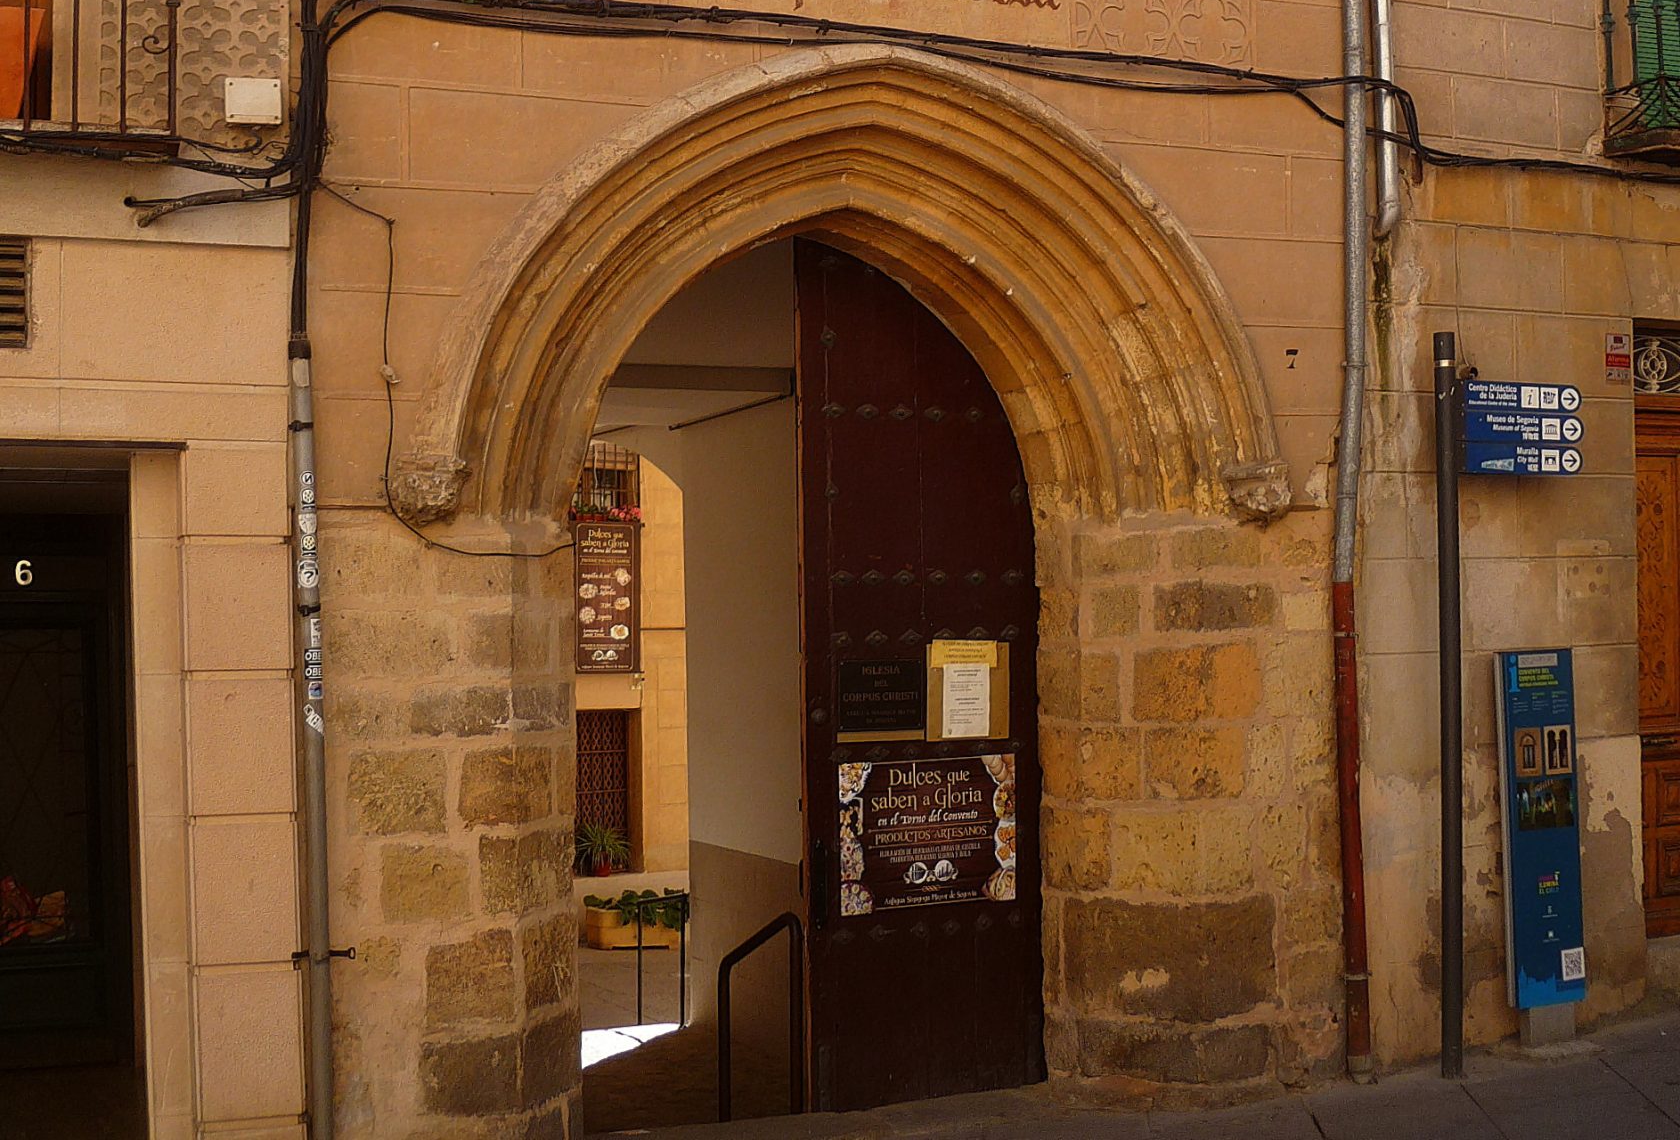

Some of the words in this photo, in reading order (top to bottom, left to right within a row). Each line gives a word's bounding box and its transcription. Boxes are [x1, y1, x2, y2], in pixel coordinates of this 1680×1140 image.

[1285, 348, 1299, 369] 7
[1468, 383, 1489, 392] Centro
[1489, 384, 1517, 393] Didáctico
[1488, 392, 1495, 400] la
[1486, 414, 1506, 424] Museo
[1507, 415, 1515, 424] de
[1516, 415, 1539, 425] Segovia
[1516, 446, 1539, 455] Muralla
[588, 528, 611, 539] Dulces
[608, 538, 630, 548] Gloria
[15, 559, 33, 586] 6
[862, 665, 900, 675] IGLESIA
[842, 692, 881, 702] CORPUS
[882, 691, 919, 701] CHRISTI
[889, 763, 942, 789] Dulces
[947, 769, 970, 785] que
[871, 787, 918, 812] saben
[922, 795, 931, 806] a
[934, 783, 982, 809] Gloria
[877, 817, 888, 827] en
[890, 812, 899, 825] el
[900, 814, 926, 825] Torno
[928, 809, 942, 823] del
[875, 830, 931, 845] PRODUCTOS
[933, 826, 987, 839] ARTESANOS
